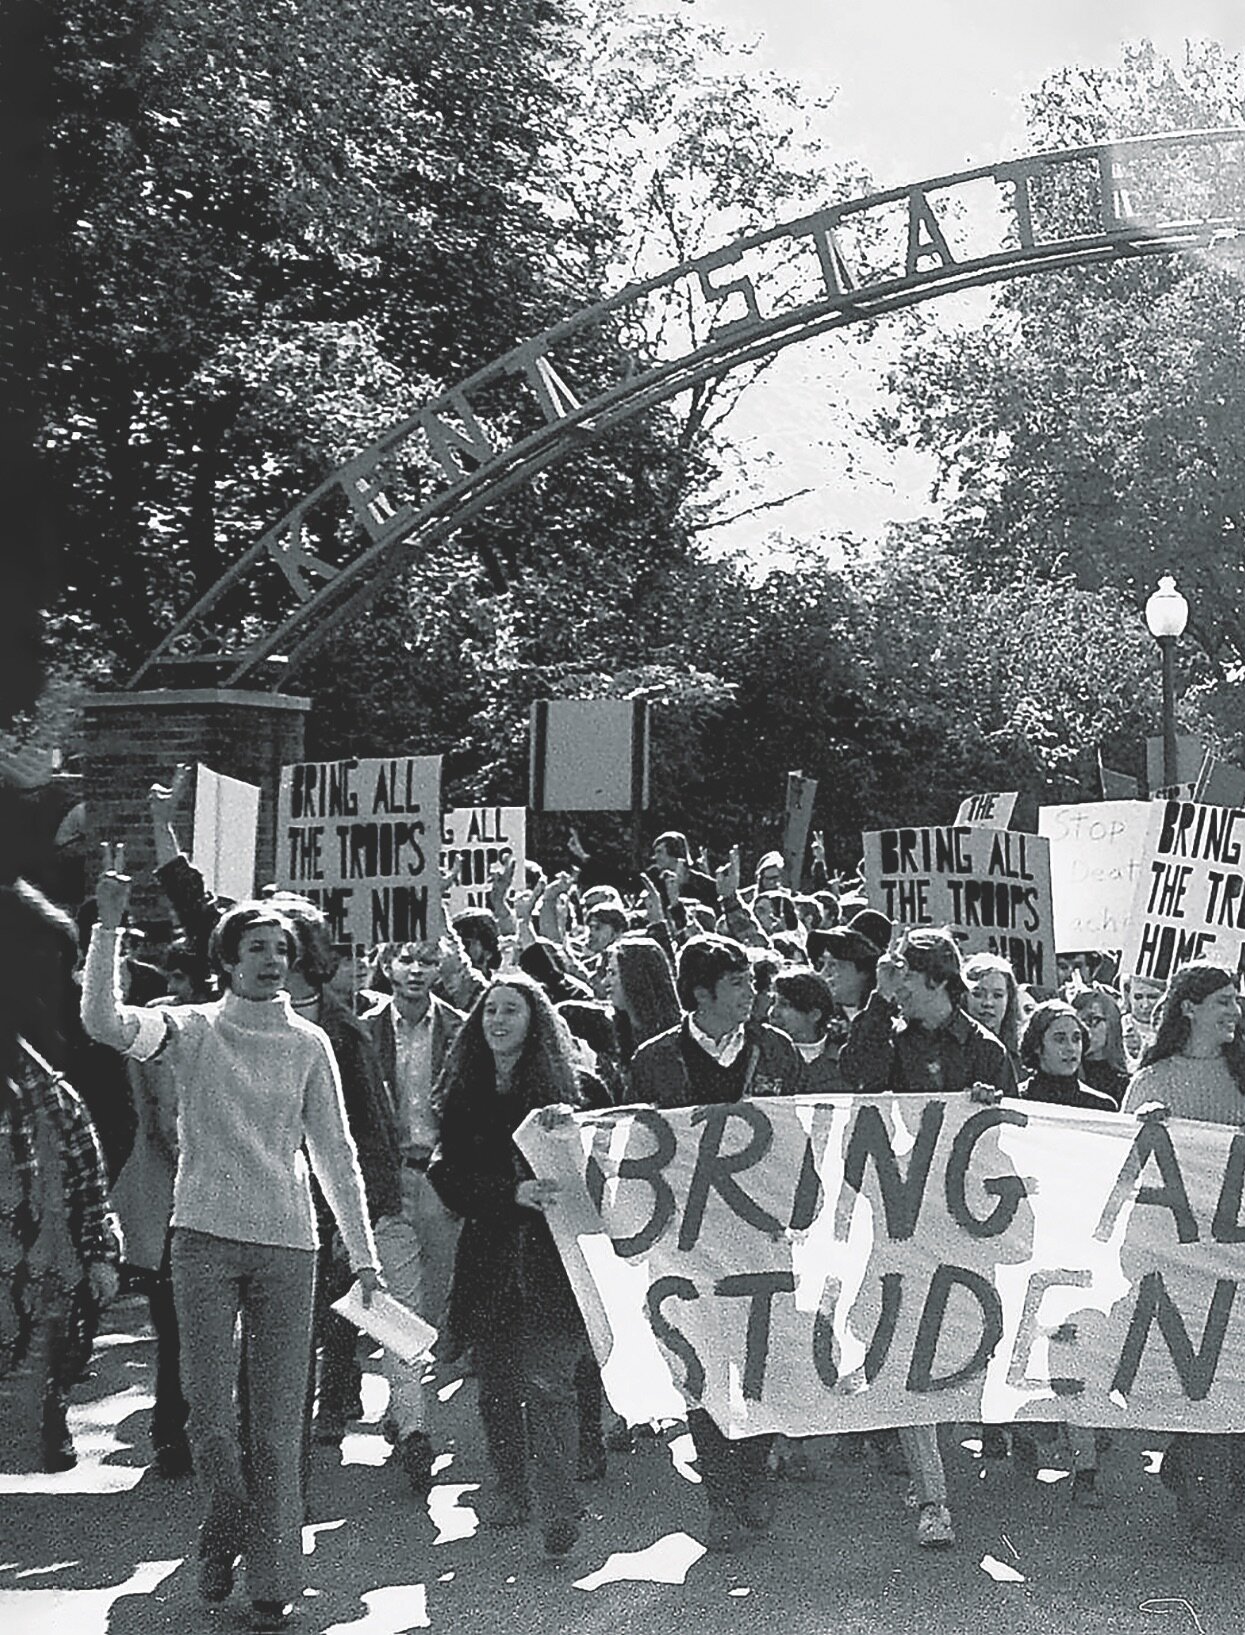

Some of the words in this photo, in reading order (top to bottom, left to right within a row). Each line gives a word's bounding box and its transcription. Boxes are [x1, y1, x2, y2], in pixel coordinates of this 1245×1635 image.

[265, 335, 570, 602] KENT
[291, 760, 358, 818] BRING
[372, 760, 420, 814] ALL
[968, 795, 1000, 821] THE
[288, 827, 324, 880] THE
[336, 821, 425, 879] TROOPS
[468, 808, 508, 843] ALL
[881, 827, 972, 874] BRING
[989, 832, 1034, 880] ALL
[372, 886, 428, 943] NOW
[880, 879, 932, 923] THE
[948, 880, 1039, 932] TROOPS
[1147, 861, 1193, 918] THE
[580, 1100, 1040, 1259] BRING
